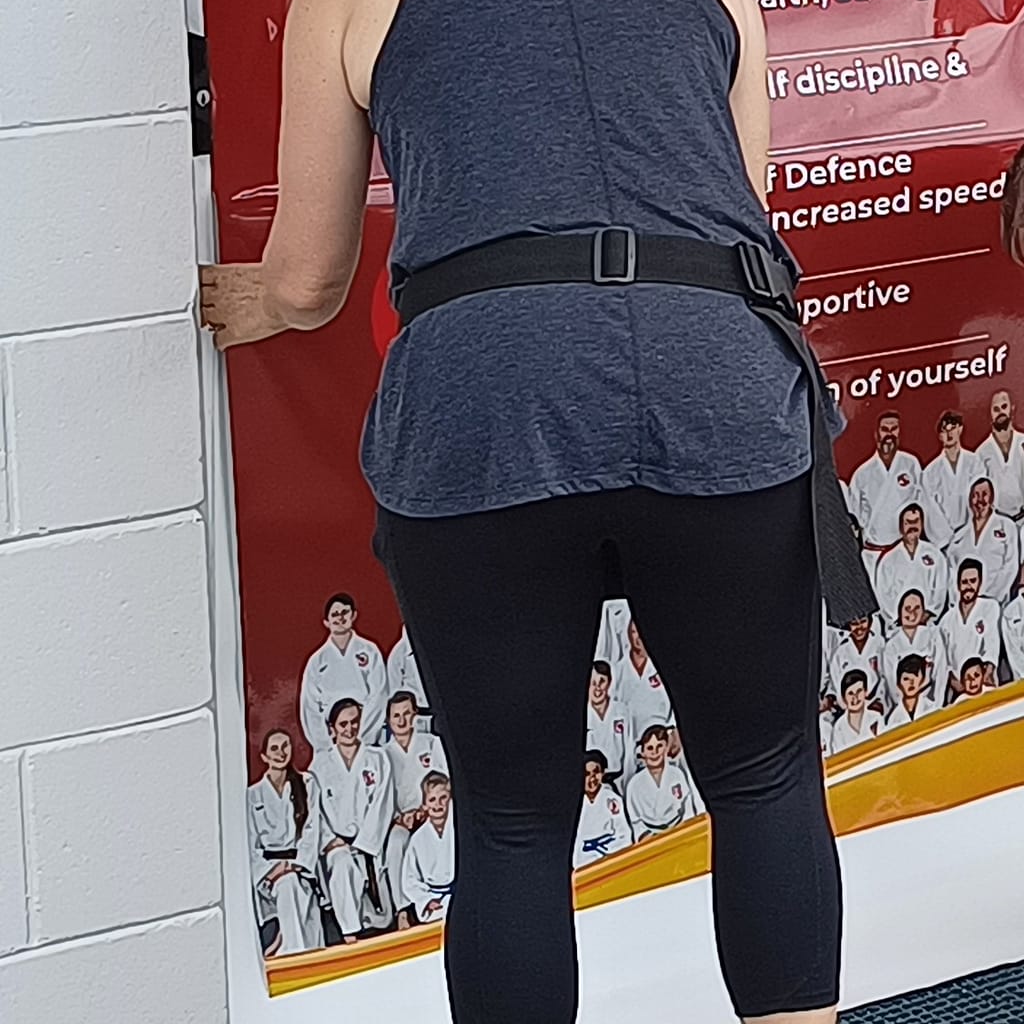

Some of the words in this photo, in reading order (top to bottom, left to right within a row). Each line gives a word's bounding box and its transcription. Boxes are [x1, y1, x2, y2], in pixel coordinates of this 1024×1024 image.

[796, 54, 940, 93] discipline
[946, 51, 968, 77] &
[785, 153, 912, 190] Defence
[772, 185, 911, 231] ncreased
[919, 172, 1007, 214] speed
[797, 280, 910, 325] portive
[850, 368, 882, 397] of
[887, 344, 1008, 398] yourself
